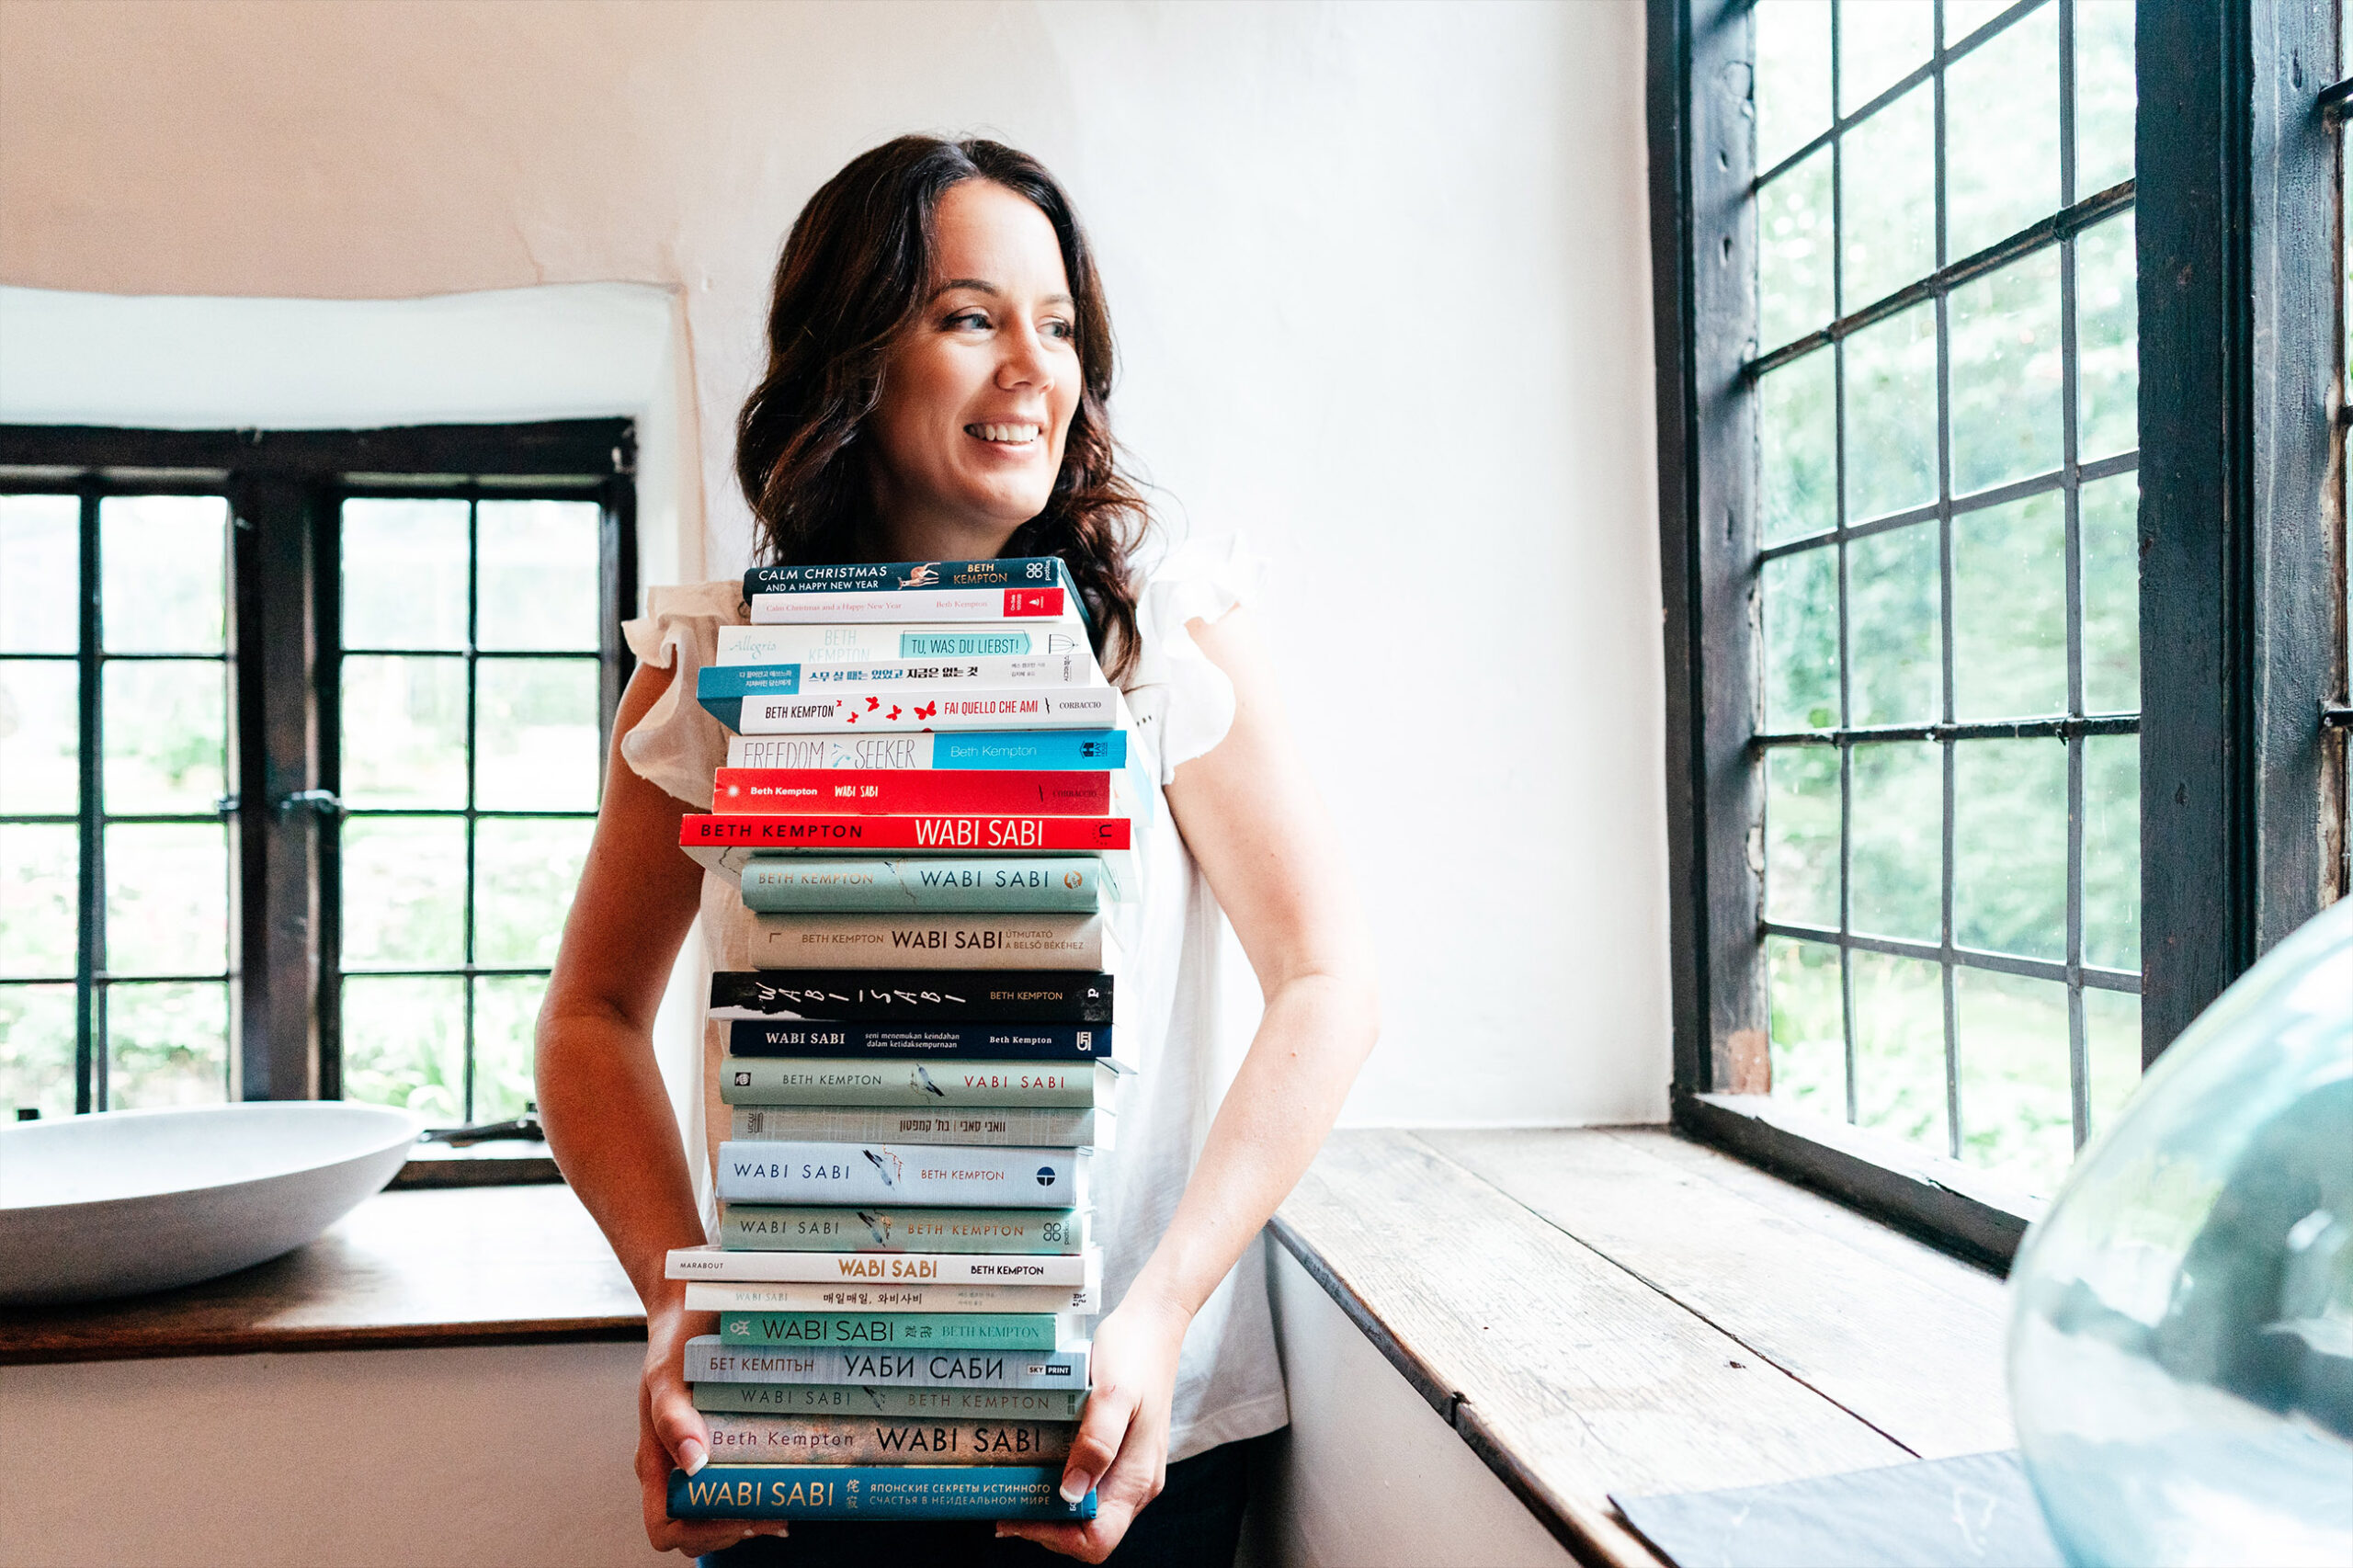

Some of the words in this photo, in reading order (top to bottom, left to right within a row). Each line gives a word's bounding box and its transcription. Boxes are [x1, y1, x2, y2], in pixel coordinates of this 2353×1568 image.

[758, 570, 799, 581] CALM
[804, 565, 888, 579] CHRISTMAS
[967, 563, 995, 573] BETH
[953, 573, 1008, 585] KEMPTON
[766, 583, 786, 592] AND
[789, 582, 796, 591] A
[798, 582, 827, 591] HAPPY
[830, 581, 853, 589] NEW
[856, 580, 879, 588] YEAR
[842, 603, 864, 612] Happy
[936, 600, 952, 608] Beth
[954, 599, 988, 609] Kempton
[824, 629, 857, 645] BETH
[930, 639, 955, 653] WAS
[959, 639, 974, 653] DU
[978, 638, 1019, 653] LIEBST!
[808, 648, 870, 664] KEMPTON
[808, 672, 829, 682] 스무
[833, 671, 844, 681] 살
[847, 671, 868, 681] 때는
[870, 669, 903, 680] 있었고
[906, 667, 939, 679] 지금은
[942, 667, 964, 677] 없는
[967, 665, 979, 676] 것
[944, 702, 959, 715] FAI
[961, 701, 995, 715] QUELLO
[998, 701, 1017, 713] CHE
[1019, 700, 1039, 713] AMI
[1059, 701, 1101, 710] CORBACCIO
[765, 707, 788, 719] BETH
[790, 706, 834, 718] KEMPTON
[744, 741, 824, 768] FREEDOM
[855, 739, 916, 769] SEEKER
[950, 746, 979, 757] Beth
[982, 745, 1037, 761] Kempton
[750, 787, 773, 795] Beth
[775, 787, 818, 796] Kempton
[835, 786, 856, 798] WABI
[860, 786, 879, 798] SABI
[701, 824, 752, 837] BETH
[763, 825, 862, 838] KEMPTON
[915, 819, 980, 846] WABI
[987, 820, 1043, 846] SABI
[758, 872, 794, 884] BETH
[801, 873, 873, 885] KEMPTON
[920, 870, 981, 888] WABI
[995, 870, 1049, 888] SABI
[801, 935, 828, 943] BETH
[831, 934, 884, 944] KEMPTON
[892, 931, 948, 949] WABI
[954, 931, 1002, 949] SABI
[1043, 940, 1084, 949] BÉKÉHEZ
[990, 992, 1014, 1000] BETH
[1017, 992, 1063, 1000] KEMPTON
[766, 1032, 805, 1044] WABI
[810, 1032, 846, 1044] SABI
[924, 1032, 960, 1040] keindahan
[989, 1036, 1009, 1044] Beth
[1012, 1036, 1052, 1046] Kempton
[890, 1040, 957, 1050] ketidaksempurnaan
[782, 1074, 813, 1085] BETH
[819, 1074, 882, 1085] KEMPTON
[964, 1075, 1007, 1088] VABI
[1020, 1076, 1064, 1089] SABI
[900, 1119, 932, 1132] קמפטון
[960, 1120, 981, 1132] סאבי
[984, 1121, 1006, 1132] וואבי
[734, 1164, 788, 1178] WABI
[802, 1165, 849, 1179] SABI
[921, 1170, 947, 1179] BETH
[951, 1170, 1005, 1181] KEMPTON
[740, 1221, 786, 1233] WABI
[798, 1221, 839, 1234] SABI
[908, 1224, 943, 1235] BETH
[952, 1225, 1024, 1236] KEMPTON
[838, 1258, 885, 1278] WABI
[892, 1259, 938, 1278] SABI
[971, 1266, 995, 1275] BETH
[997, 1266, 1044, 1276] KEMPTON
[735, 1292, 762, 1301] WABI
[765, 1292, 788, 1301] SABI
[824, 1292, 872, 1305] 매일매일,
[878, 1293, 923, 1305] 와비사비
[762, 1319, 827, 1340] WABI
[835, 1320, 893, 1342] SABI
[942, 1325, 976, 1337] BETH
[980, 1326, 1040, 1338] KEMPTON
[710, 1357, 735, 1370] БЕТ
[741, 1358, 814, 1372] КЕМПТЪН
[845, 1355, 915, 1378] УАБИ
[929, 1356, 1004, 1380] САБИ
[741, 1389, 792, 1404] WABI
[805, 1391, 851, 1406] SABI
[908, 1393, 951, 1406] BETH
[962, 1395, 1050, 1409] KEMPTON
[712, 1431, 757, 1446] Beth
[768, 1432, 854, 1448] Kempton
[876, 1427, 958, 1452] WABI
[973, 1427, 1040, 1452] SABI
[688, 1482, 763, 1506] WABI
[771, 1482, 835, 1506] SABI
[870, 1483, 929, 1494] ЯПОНСКИЕ
[932, 1483, 980, 1494] СЕКРЕТЫ
[983, 1483, 1051, 1494] ИСТИННОГО
[870, 1495, 918, 1505] СЧАСТЬЯ
[921, 1496, 927, 1505] В
[931, 1495, 1017, 1506] НЕИДЕАЛЬНОМ
[1020, 1495, 1051, 1505] МИРЕ
